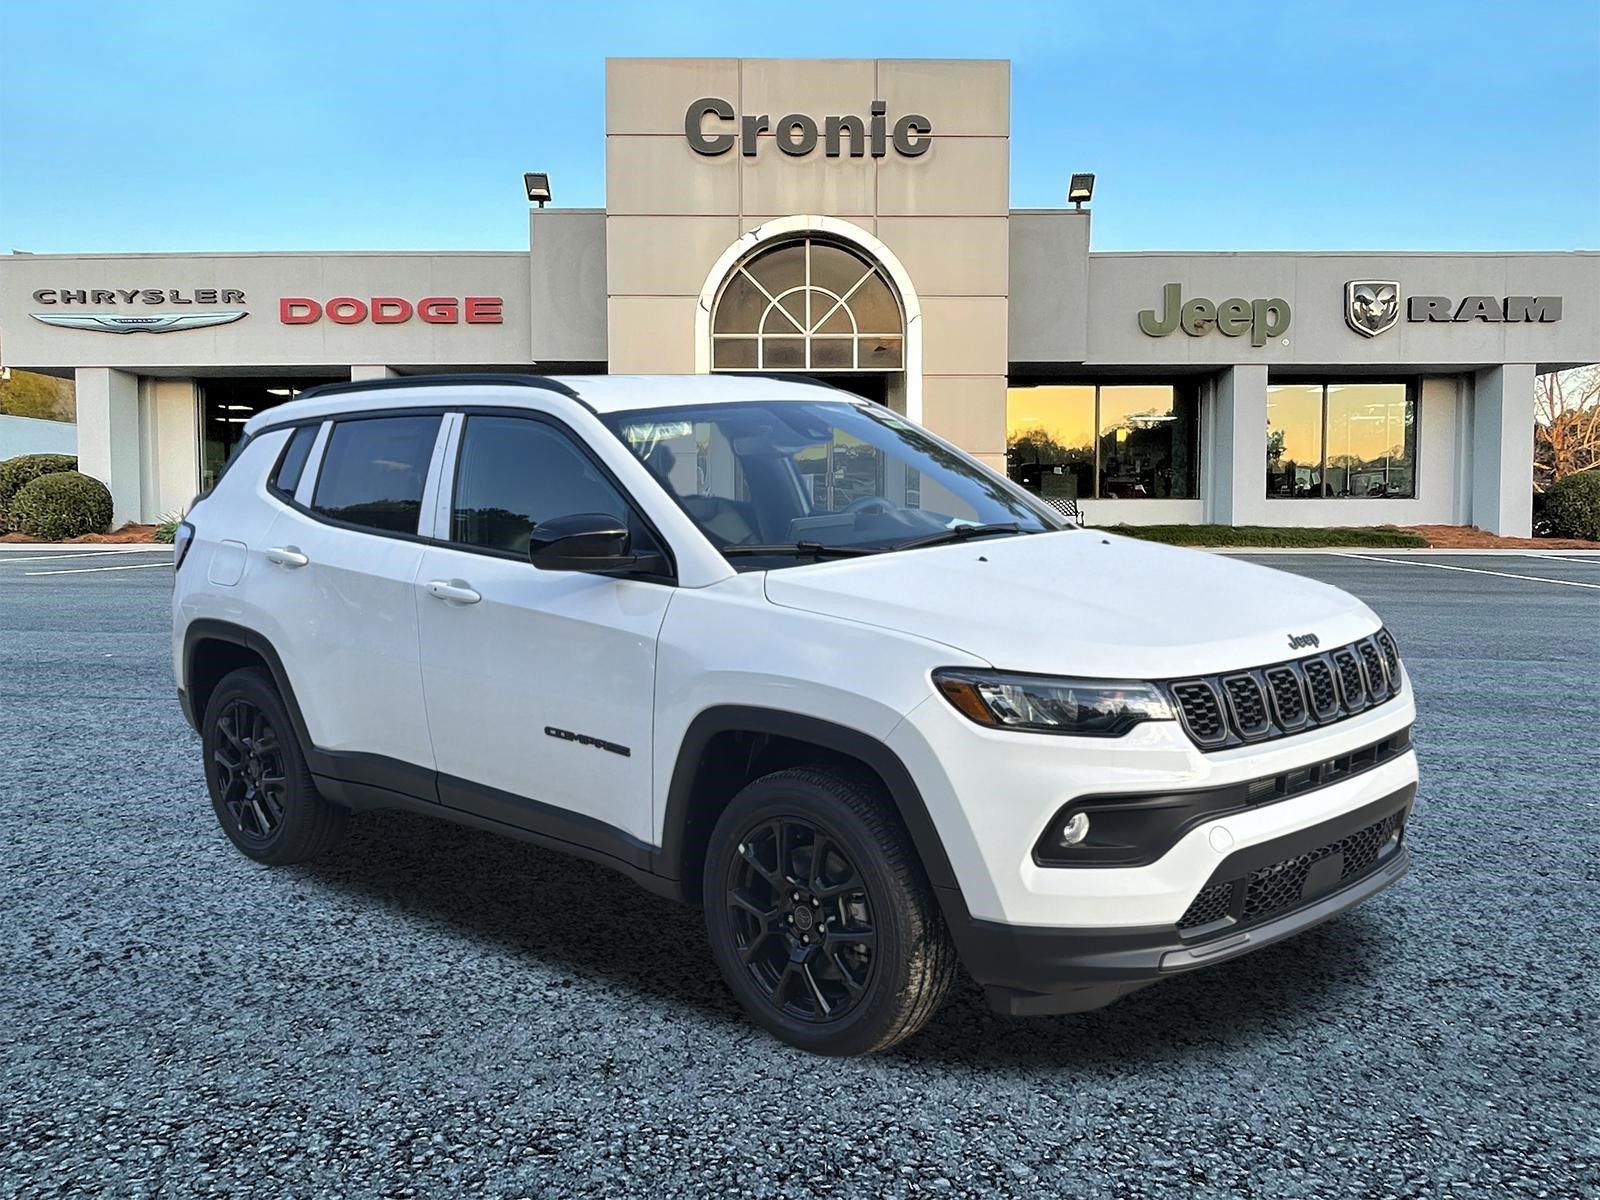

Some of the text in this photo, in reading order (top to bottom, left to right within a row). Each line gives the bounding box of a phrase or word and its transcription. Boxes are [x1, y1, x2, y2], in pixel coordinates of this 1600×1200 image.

[684, 97, 932, 157] Cronic
[32, 289, 246, 305] CHRYSLER
[280, 297, 503, 324] DODGE
[1407, 296, 1563, 323] RAM
[1138, 283, 1291, 347] Jeep
[1287, 633, 1320, 650] Jeep
